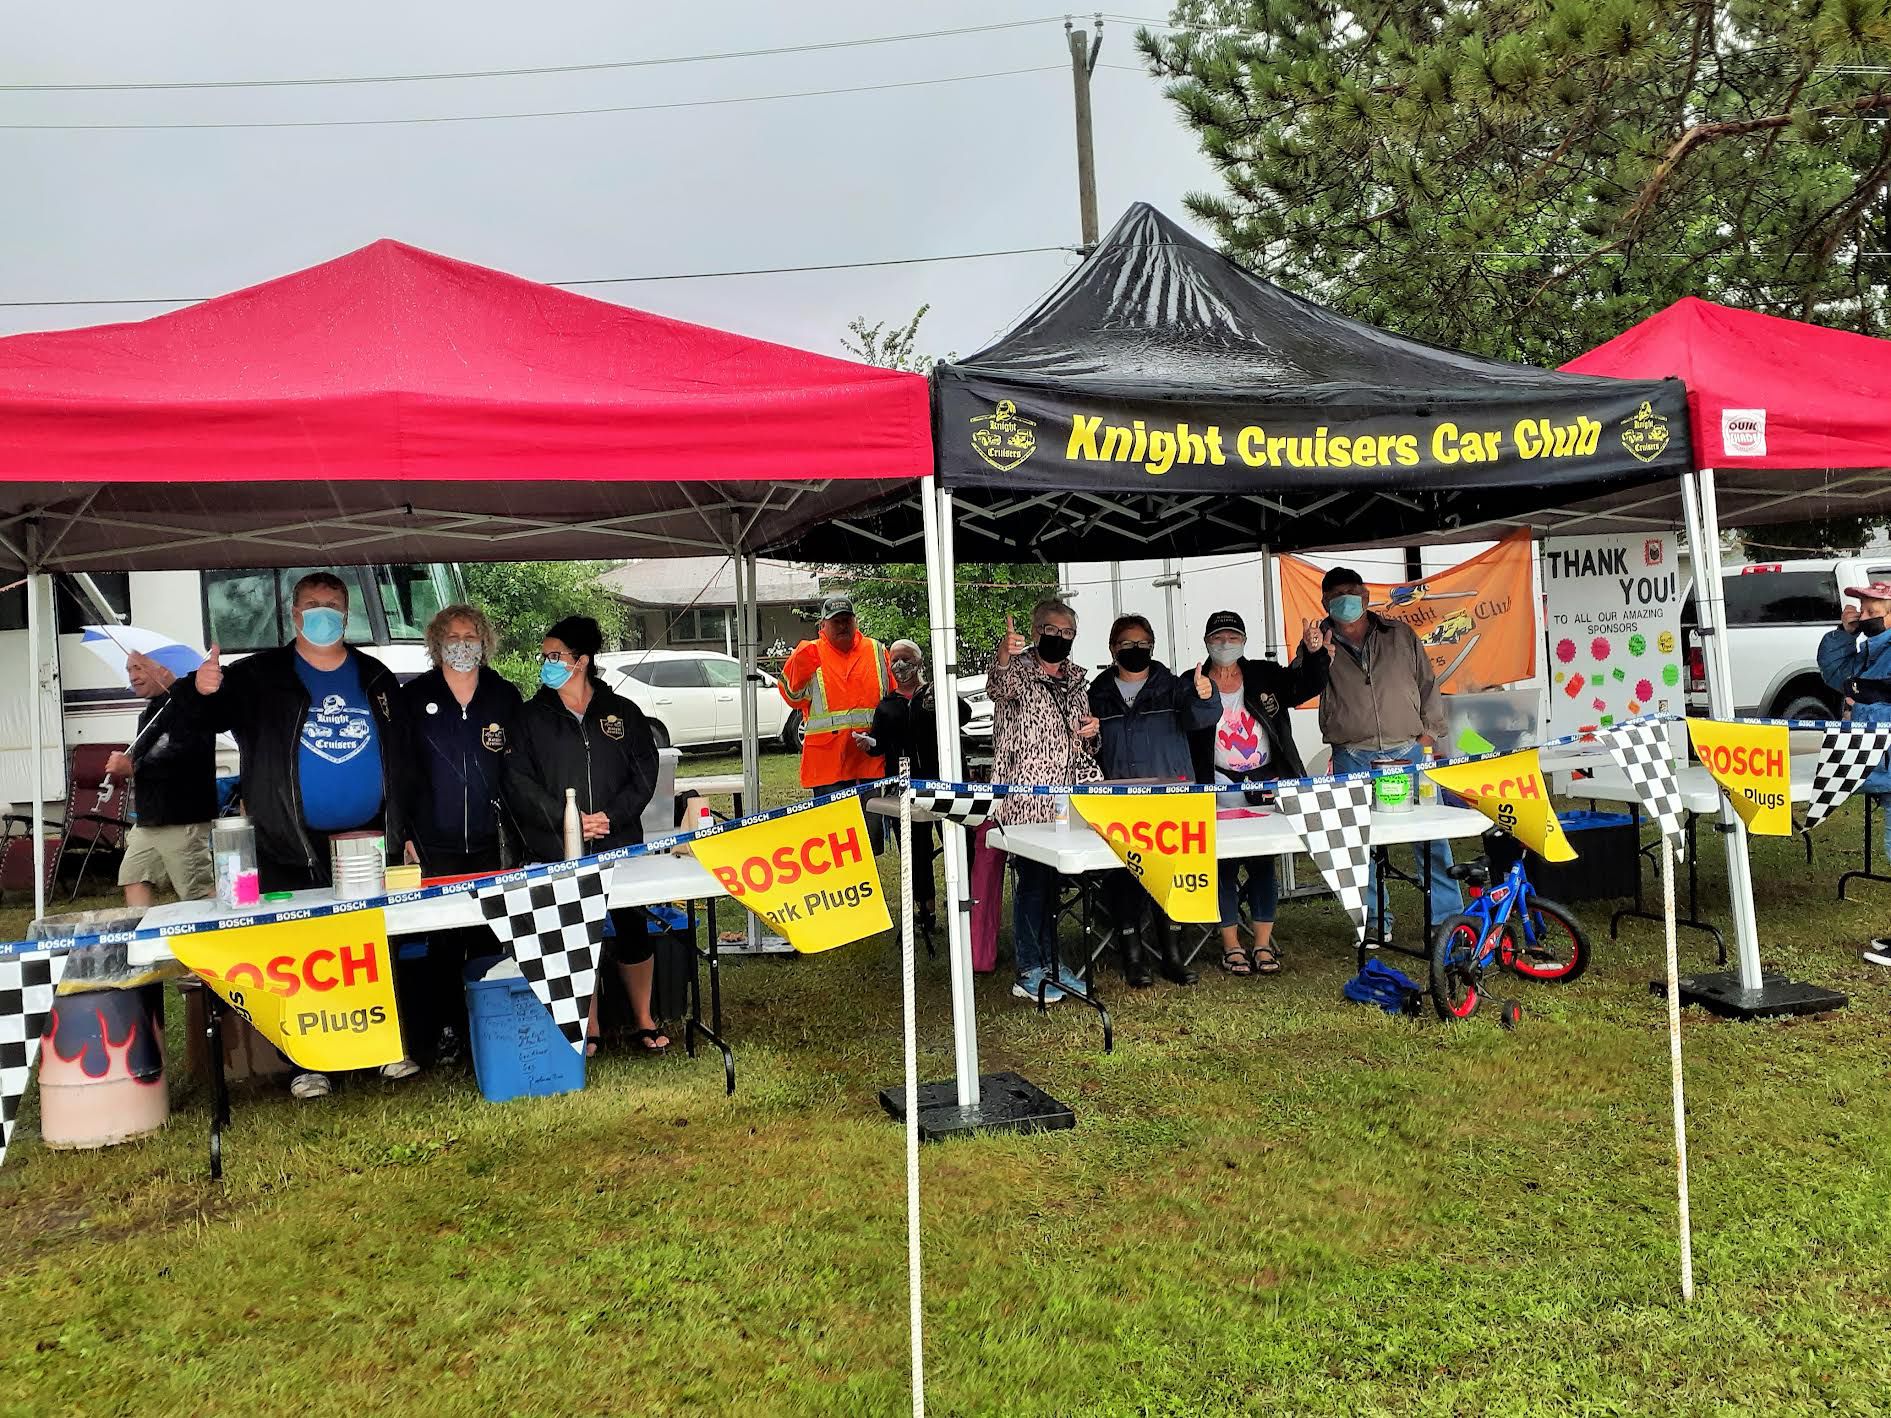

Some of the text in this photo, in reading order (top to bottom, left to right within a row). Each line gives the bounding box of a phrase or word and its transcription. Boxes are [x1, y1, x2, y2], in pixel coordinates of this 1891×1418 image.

[989, 420, 1017, 433] Knight
[987, 447, 1021, 458] Cruisers
[1065, 414, 1603, 475] Knight Cruisers Car Club
[1547, 547, 1629, 579] THANK
[1619, 572, 1676, 605] YOU!
[1554, 608, 1664, 625] TO ALL OUR AMAZING
[1588, 622, 1638, 635] SPONSORS
[316, 713, 349, 724] Knight
[315, 739, 357, 749] Cruisers
[1697, 745, 1784, 778] BOSCH
[925, 781, 952, 791] BOSCH
[967, 784, 993, 793] BOSCH
[1008, 785, 1034, 794] BOSCH
[1049, 785, 1074, 794] BOSCH
[1088, 786, 1113, 795] BOSCH
[1744, 788, 1785, 810] Plugs
[1088, 821, 1206, 855] OSCH
[37, 938, 75, 950] BOSCH
[99, 931, 137, 943] BOSCH
[159, 923, 196, 936] BOSCH
[218, 917, 254, 929] BOSCH
[275, 910, 311, 922] BOSCH
[332, 901, 367, 914] BOSCH
[387, 891, 422, 904] BOSCH
[442, 881, 475, 895] BOSCH
[495, 872, 528, 885] BOSCH
[547, 860, 579, 874] BOSCH
[598, 848, 629, 863] BOSCH
[647, 837, 677, 851] BOSCH
[694, 825, 724, 839] BOSCH
[741, 812, 770, 827] BOSCH
[786, 801, 814, 815] BOSCH
[830, 788, 858, 802] BOSCH
[712, 826, 863, 897] BOSCH
[766, 881, 873, 925] ark Plugs
[192, 943, 379, 998] OSCH
[297, 1006, 386, 1036] Plugs
